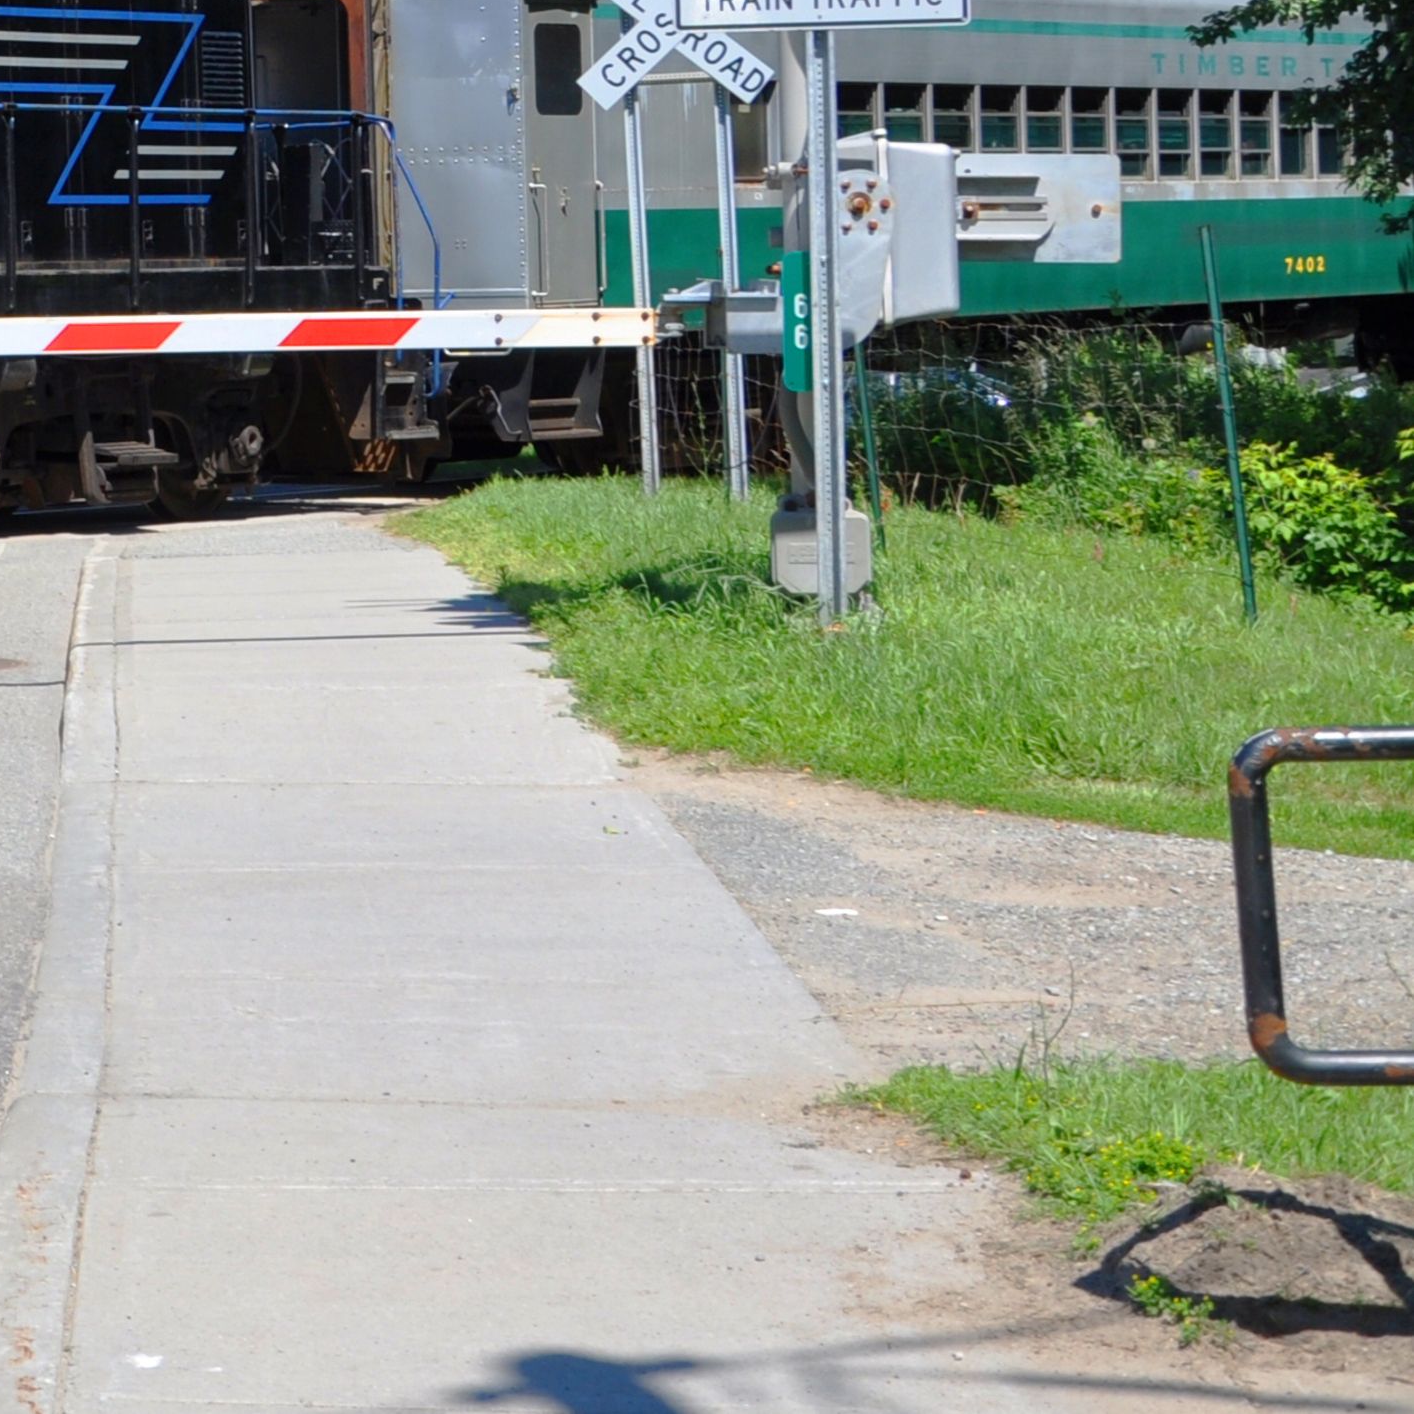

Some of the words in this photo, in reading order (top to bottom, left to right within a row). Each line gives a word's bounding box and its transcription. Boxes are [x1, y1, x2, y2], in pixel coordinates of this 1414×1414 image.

[601, 13, 677, 87] CROS
[1151, 52, 1298, 77] TIMBER
[1284, 256, 1325, 275] 7402
[373, 277, 385, 290] F
